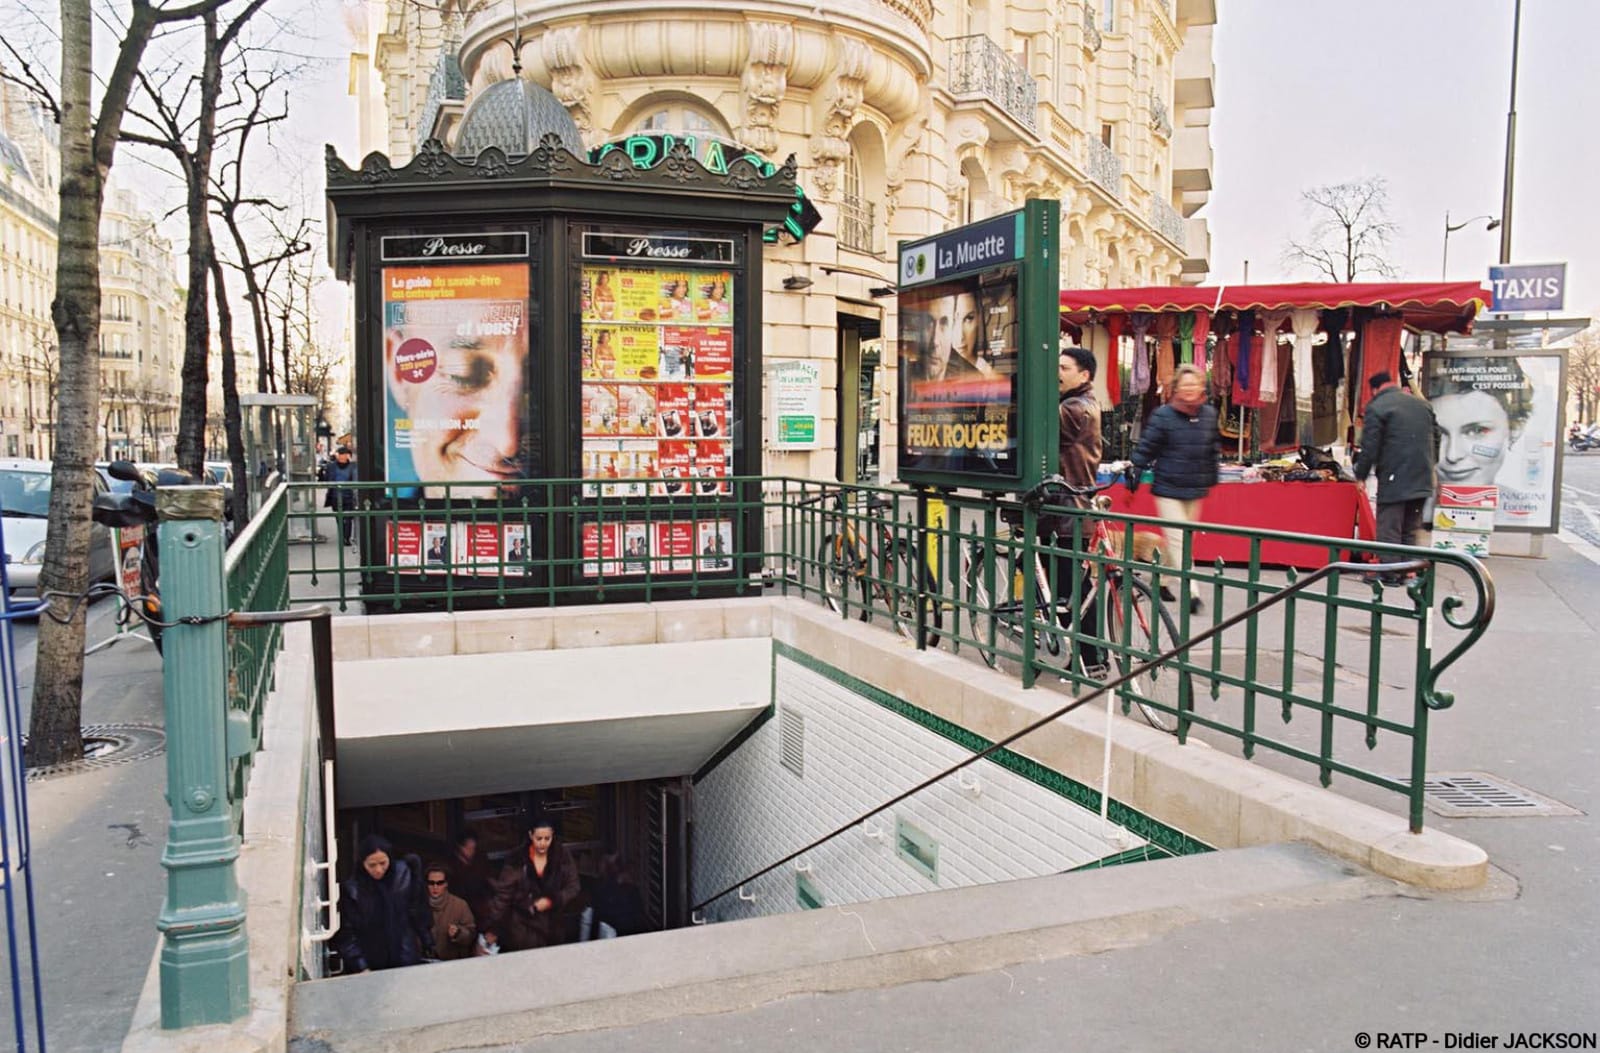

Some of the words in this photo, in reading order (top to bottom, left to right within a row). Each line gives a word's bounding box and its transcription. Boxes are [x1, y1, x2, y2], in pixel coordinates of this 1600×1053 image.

[422, 236, 486, 256] Presse
[626, 238, 692, 258] Presse
[938, 248, 953, 269] La
[956, 235, 1005, 265] Muette
[391, 277, 404, 288] Le
[406, 276, 432, 290] guide
[1495, 277, 1559, 299] TAXIS
[907, 424, 940, 447] FEUX
[942, 423, 1008, 450] ROUGES
